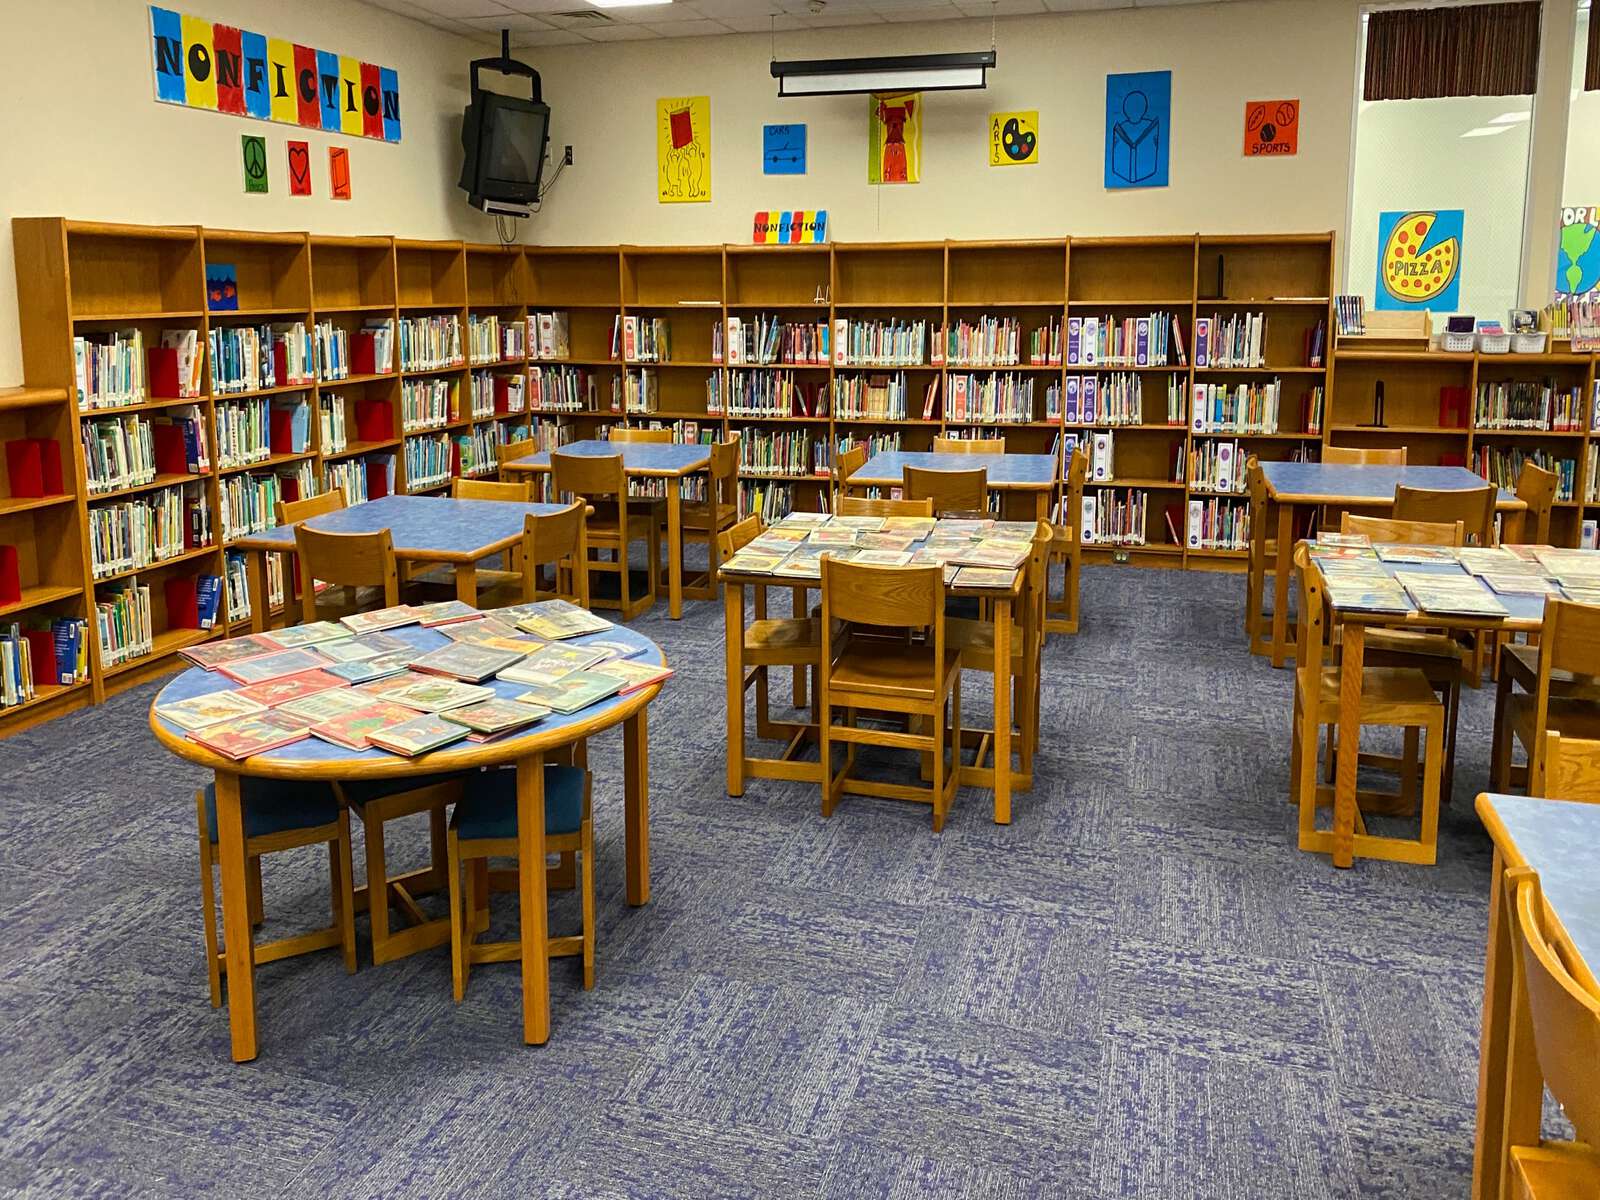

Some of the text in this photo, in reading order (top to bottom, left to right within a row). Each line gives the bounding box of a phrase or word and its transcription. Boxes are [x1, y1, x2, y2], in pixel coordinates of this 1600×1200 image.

[153, 35, 401, 121] NONFICTION
[768, 126, 790, 136] CARS
[1252, 142, 1291, 154] SPORTS
[1561, 207, 1599, 227] ORL
[753, 222, 826, 233] NONFICTION
[1394, 260, 1444, 277] PIZZA
